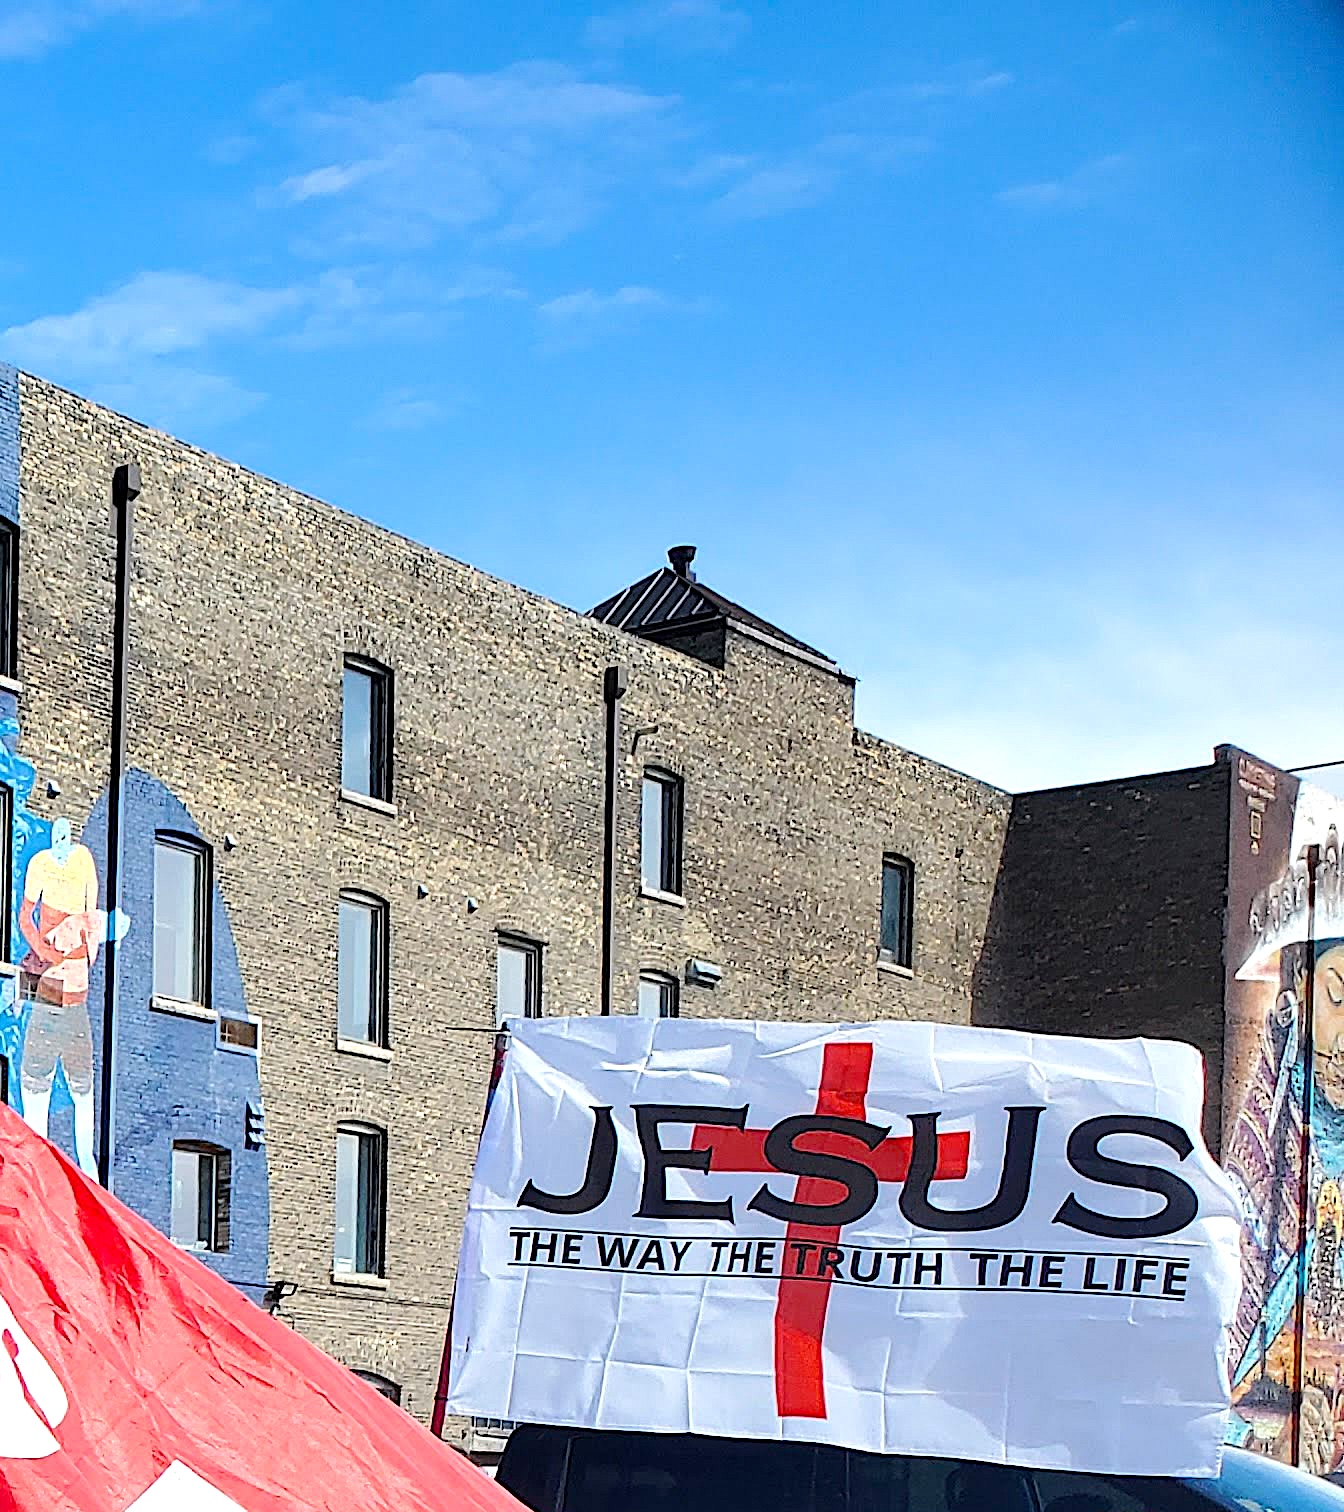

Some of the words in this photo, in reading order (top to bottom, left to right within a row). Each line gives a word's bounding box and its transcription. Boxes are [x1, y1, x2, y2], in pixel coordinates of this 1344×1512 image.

[517, 1104, 1199, 1239] JESUS
[509, 1232, 584, 1265] THE
[597, 1236, 693, 1271] WAY
[712, 1241, 776, 1273] THE
[790, 1243, 943, 1286] TRUTH
[969, 1253, 1067, 1289] THE
[1082, 1257, 1190, 1296] LIFE
